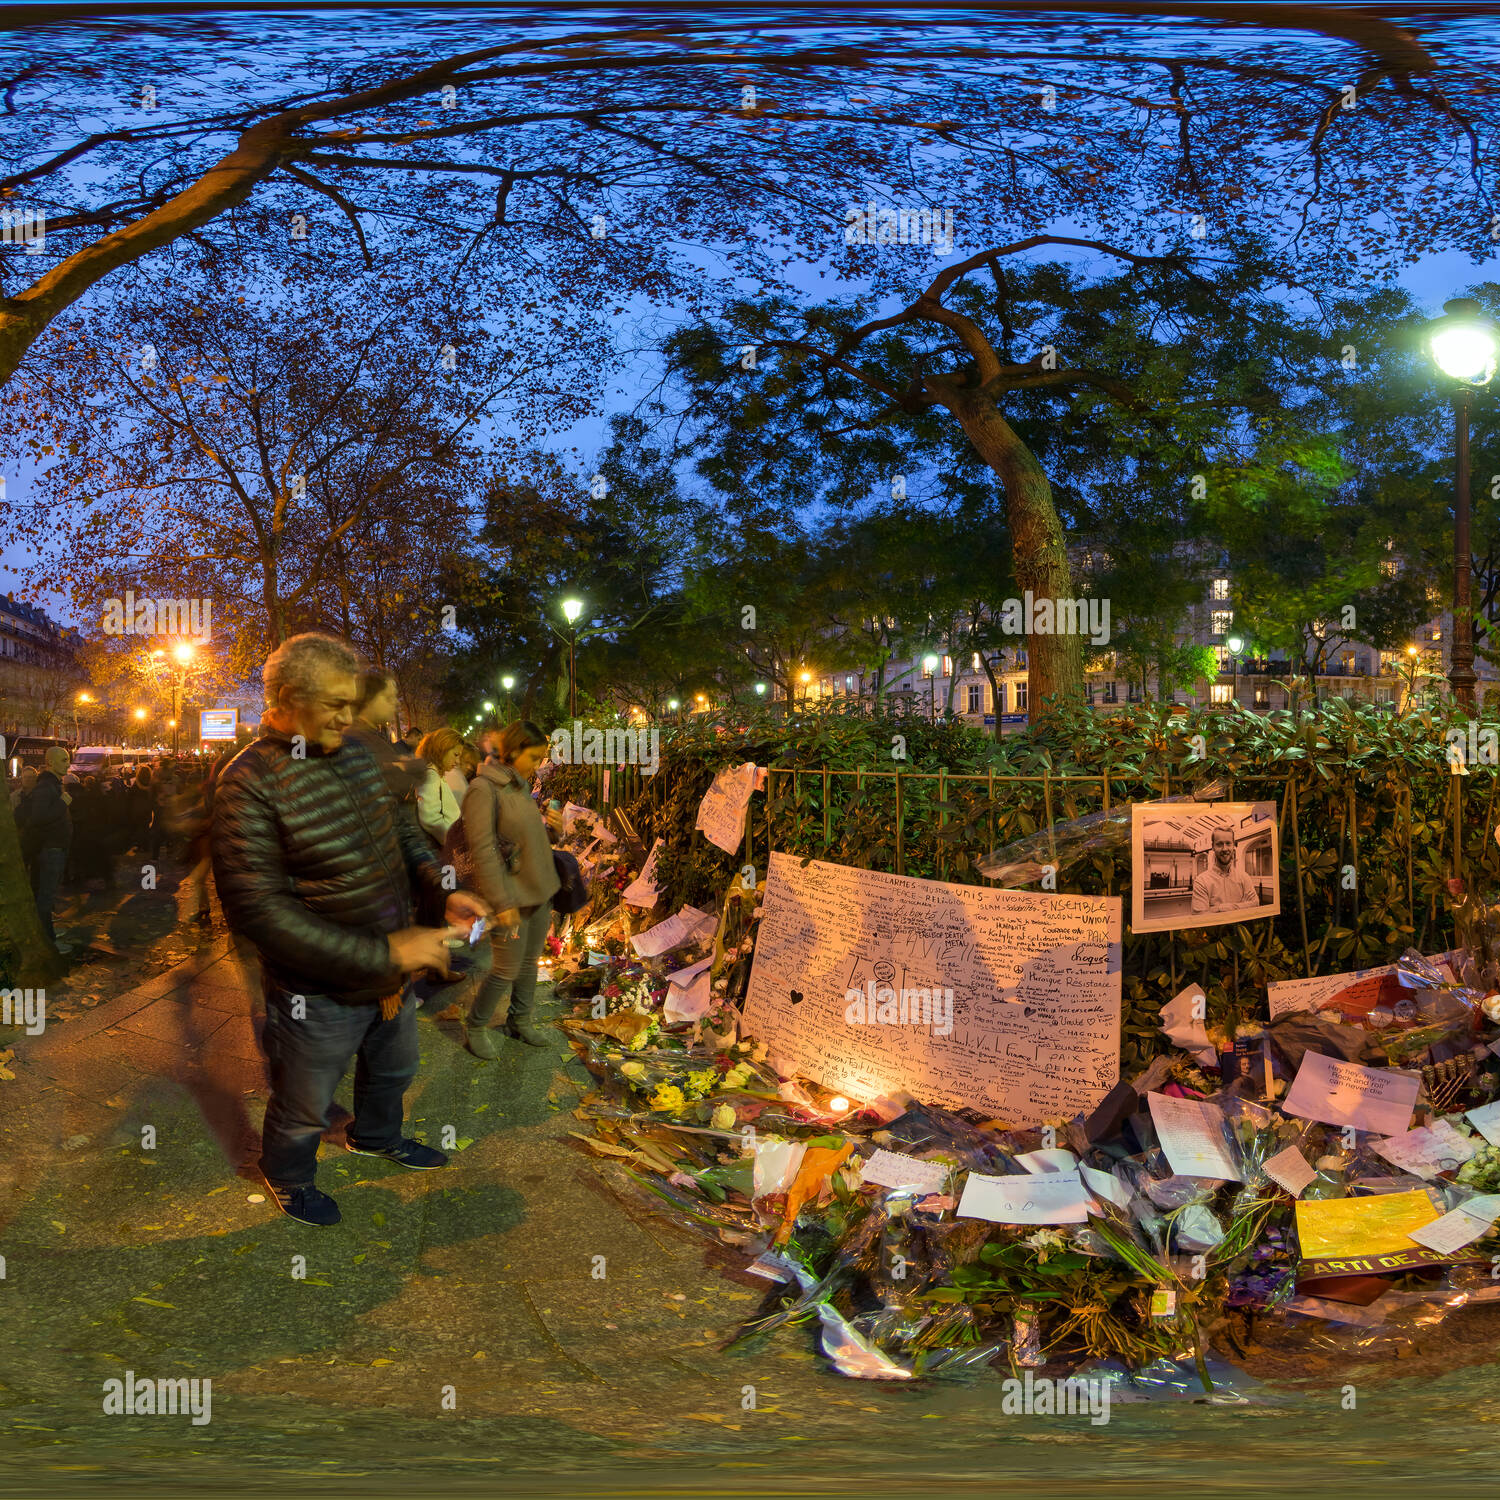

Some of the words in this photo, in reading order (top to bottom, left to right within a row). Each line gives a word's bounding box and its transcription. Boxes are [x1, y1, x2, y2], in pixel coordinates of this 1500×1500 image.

[1081, 915, 1111, 925] UNION
[944, 932, 964, 940] DEATH
[1327, 1063, 1342, 1073] Hey
[1364, 1073, 1377, 1082] my
[1379, 1077, 1391, 1085] my
[1331, 1071, 1352, 1082] Rock
[1353, 1078, 1370, 1086] and
[1371, 1081, 1384, 1089] roll
[1329, 1078, 1344, 1086] can
[1345, 1082, 1369, 1093] never
[1369, 1087, 1383, 1096] die
[1379, 1252, 1418, 1269] DE
